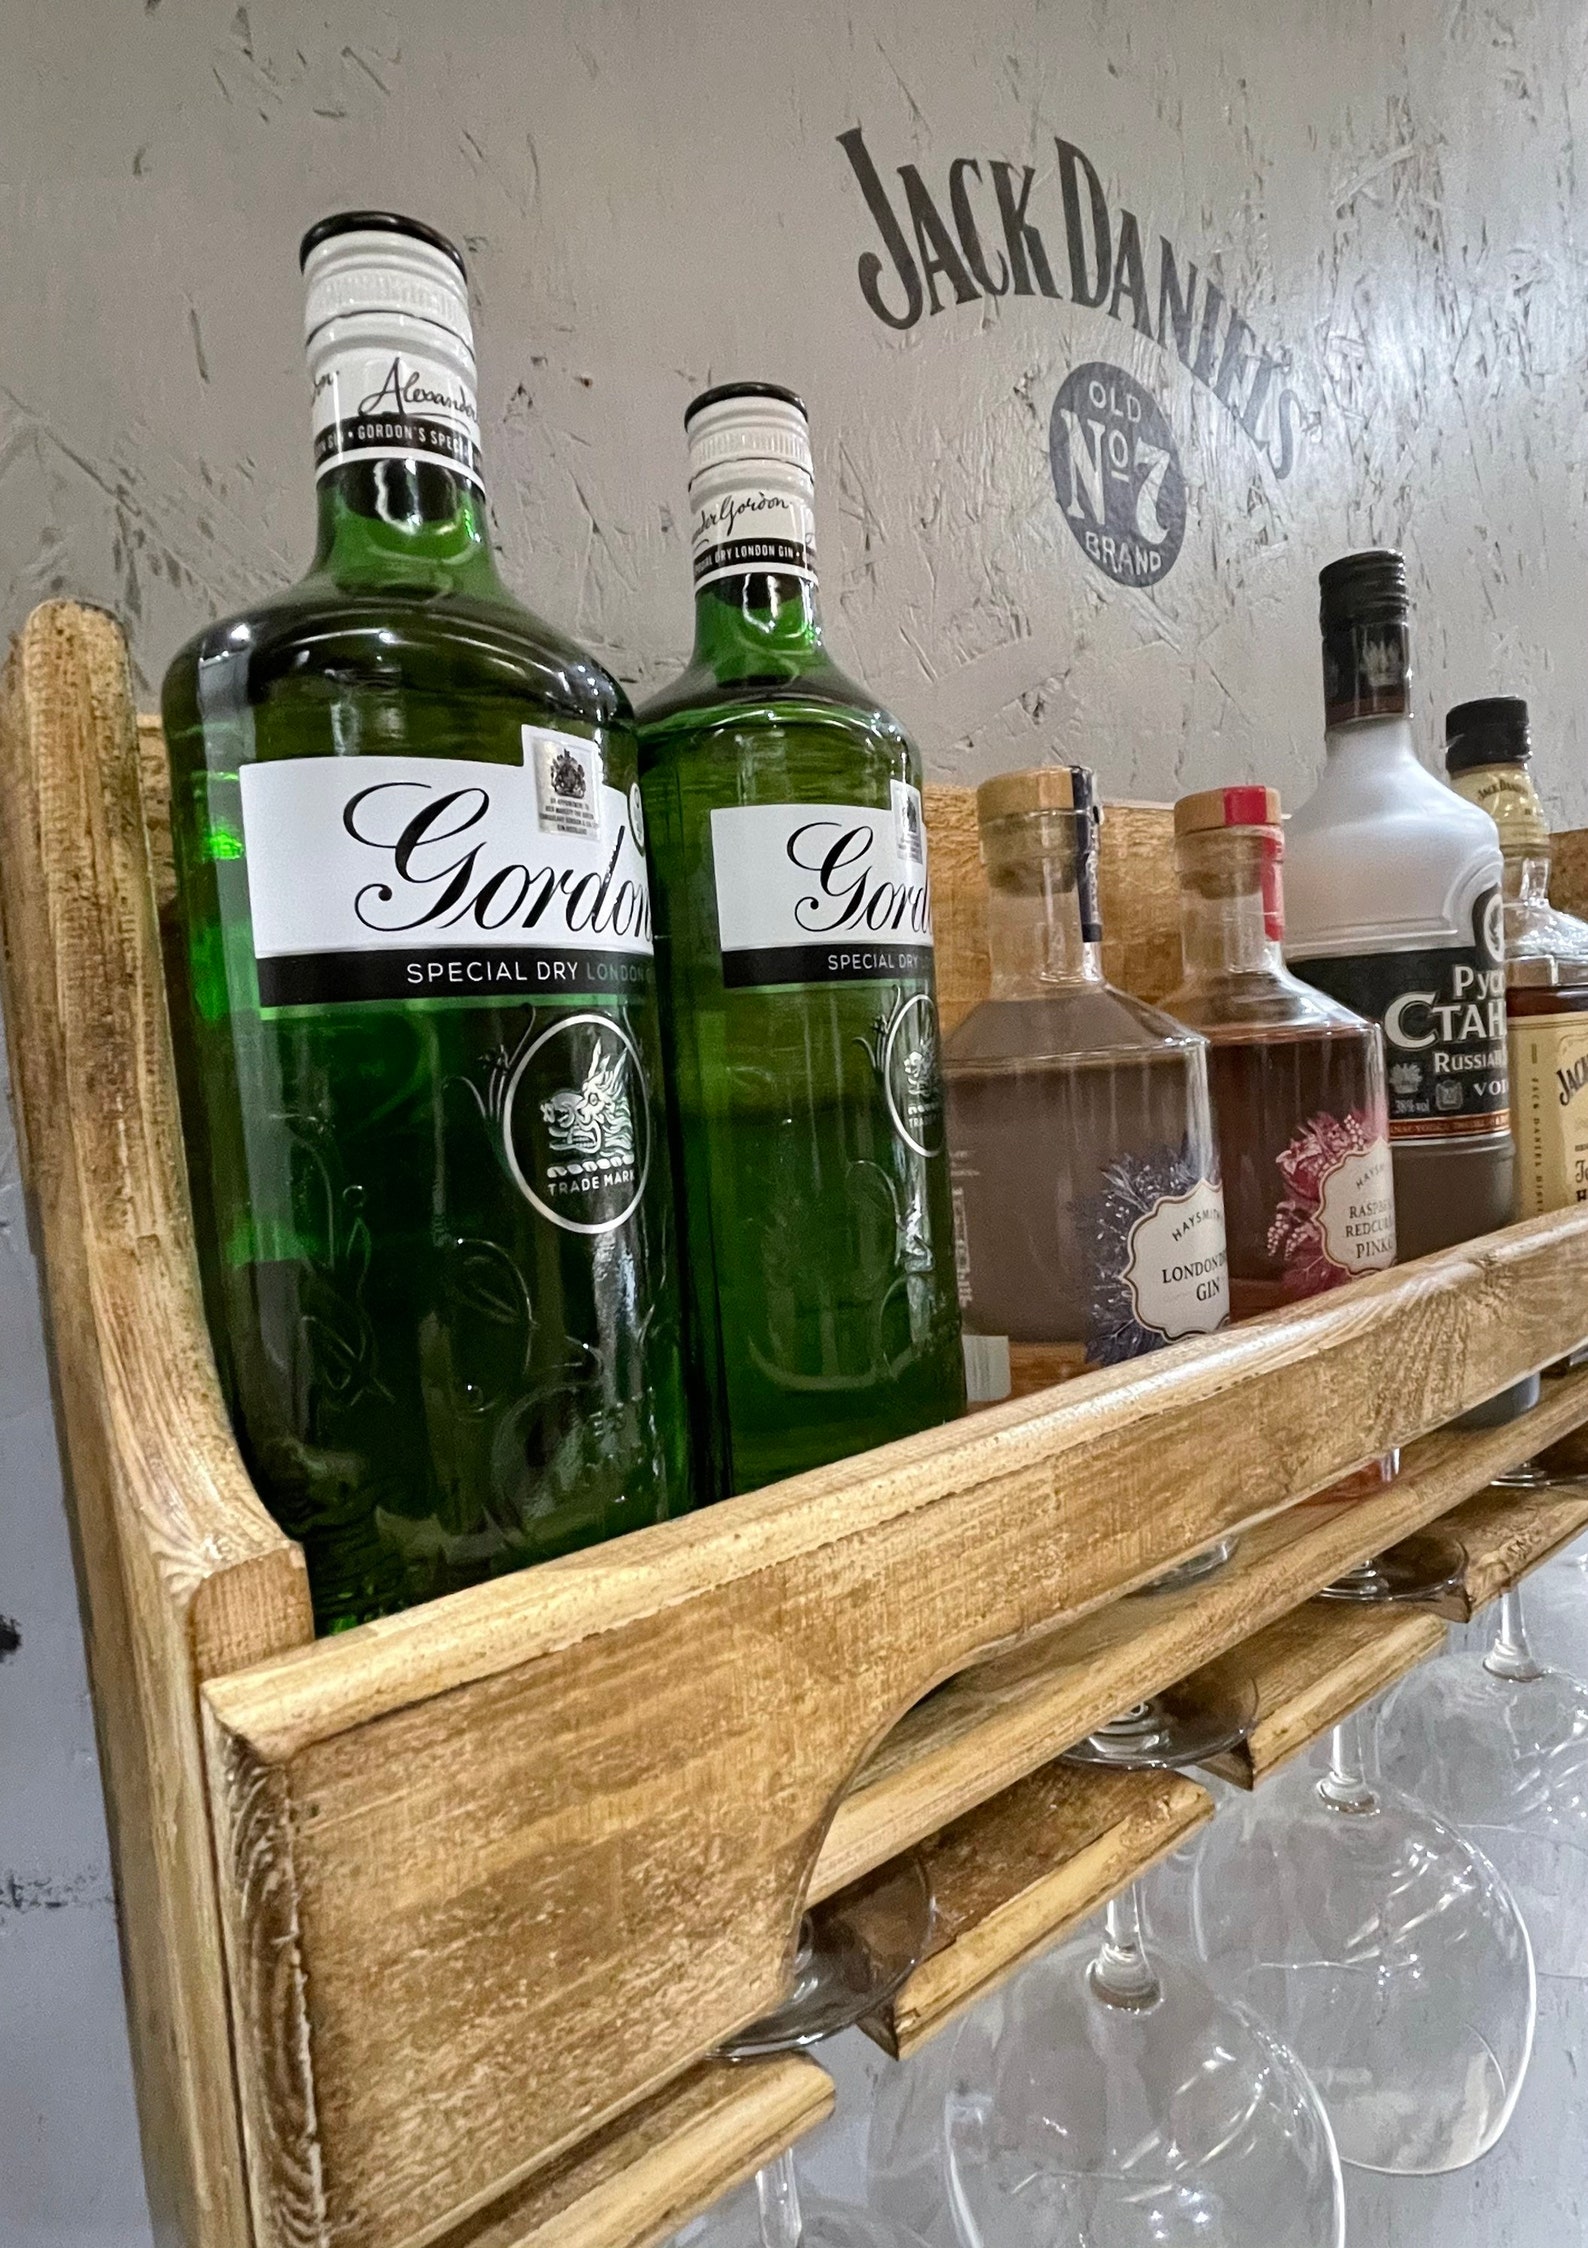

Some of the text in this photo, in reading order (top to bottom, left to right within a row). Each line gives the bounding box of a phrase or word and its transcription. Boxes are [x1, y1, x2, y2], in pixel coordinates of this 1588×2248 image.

[836, 127, 1063, 330] JACK
[1088, 380, 1142, 424] OLD
[734, 544, 776, 559] LONDON
[778, 544, 794, 559] GIN
[1085, 531, 1162, 576] BRAND
[406, 961, 528, 984] SPECIAL
[536, 961, 579, 981] DRY
[827, 954, 919, 971] SPECIAL DRY
[547, 1176, 600, 1196] TRADE
[1195, 1278, 1221, 1302] GIN
